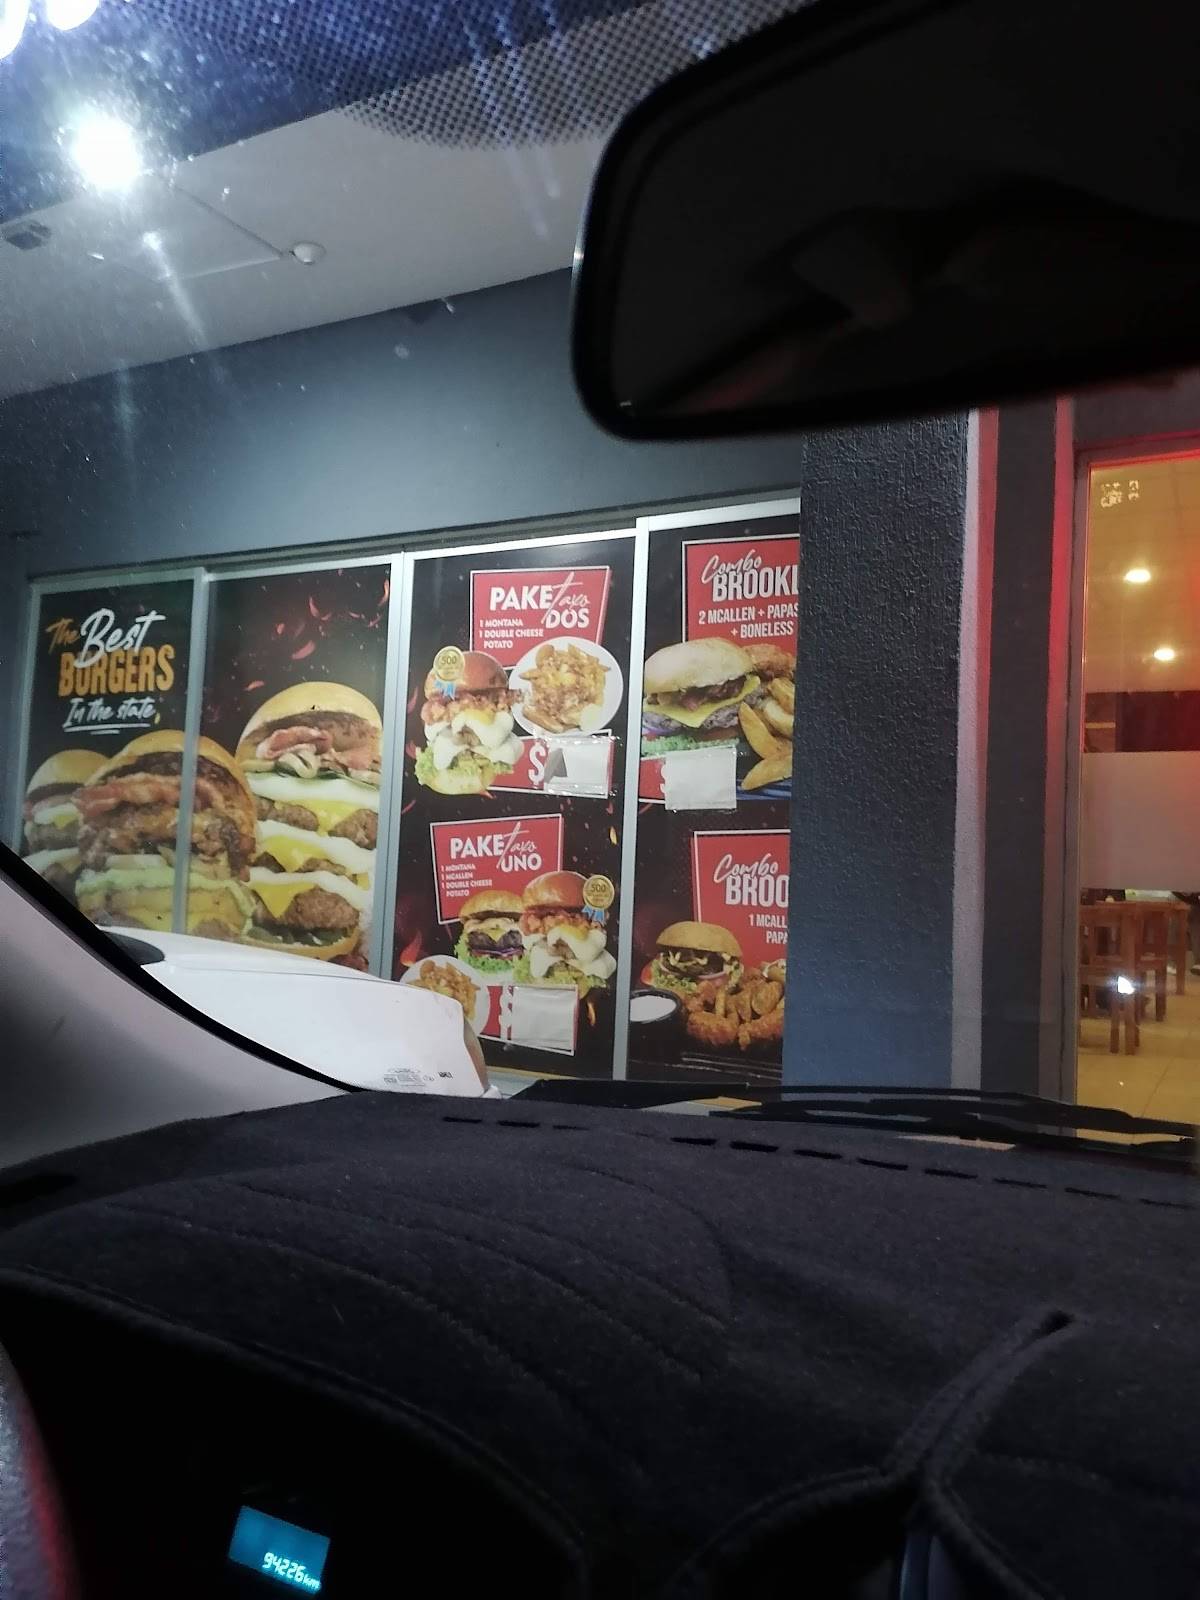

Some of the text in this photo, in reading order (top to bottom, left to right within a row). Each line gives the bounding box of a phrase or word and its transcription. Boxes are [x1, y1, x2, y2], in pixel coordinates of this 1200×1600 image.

[701, 549, 762, 584] Combo
[545, 607, 590, 629] DOS
[698, 610, 706, 625] 2
[707, 606, 756, 624] MCALLEN
[46, 608, 166, 668] The Best
[484, 629, 514, 638] DOUBLE
[515, 629, 544, 637] CHEESE
[740, 620, 795, 638] BONELESS
[483, 640, 513, 649] POTATO
[87, 698, 114, 721] the
[116, 697, 156, 719] state
[500, 853, 542, 872] UNO
[713, 853, 779, 884] Combo
[446, 889, 470, 897] POTATO
[725, 874, 790, 908] BROO
[749, 913, 788, 929] 1 MCALL
